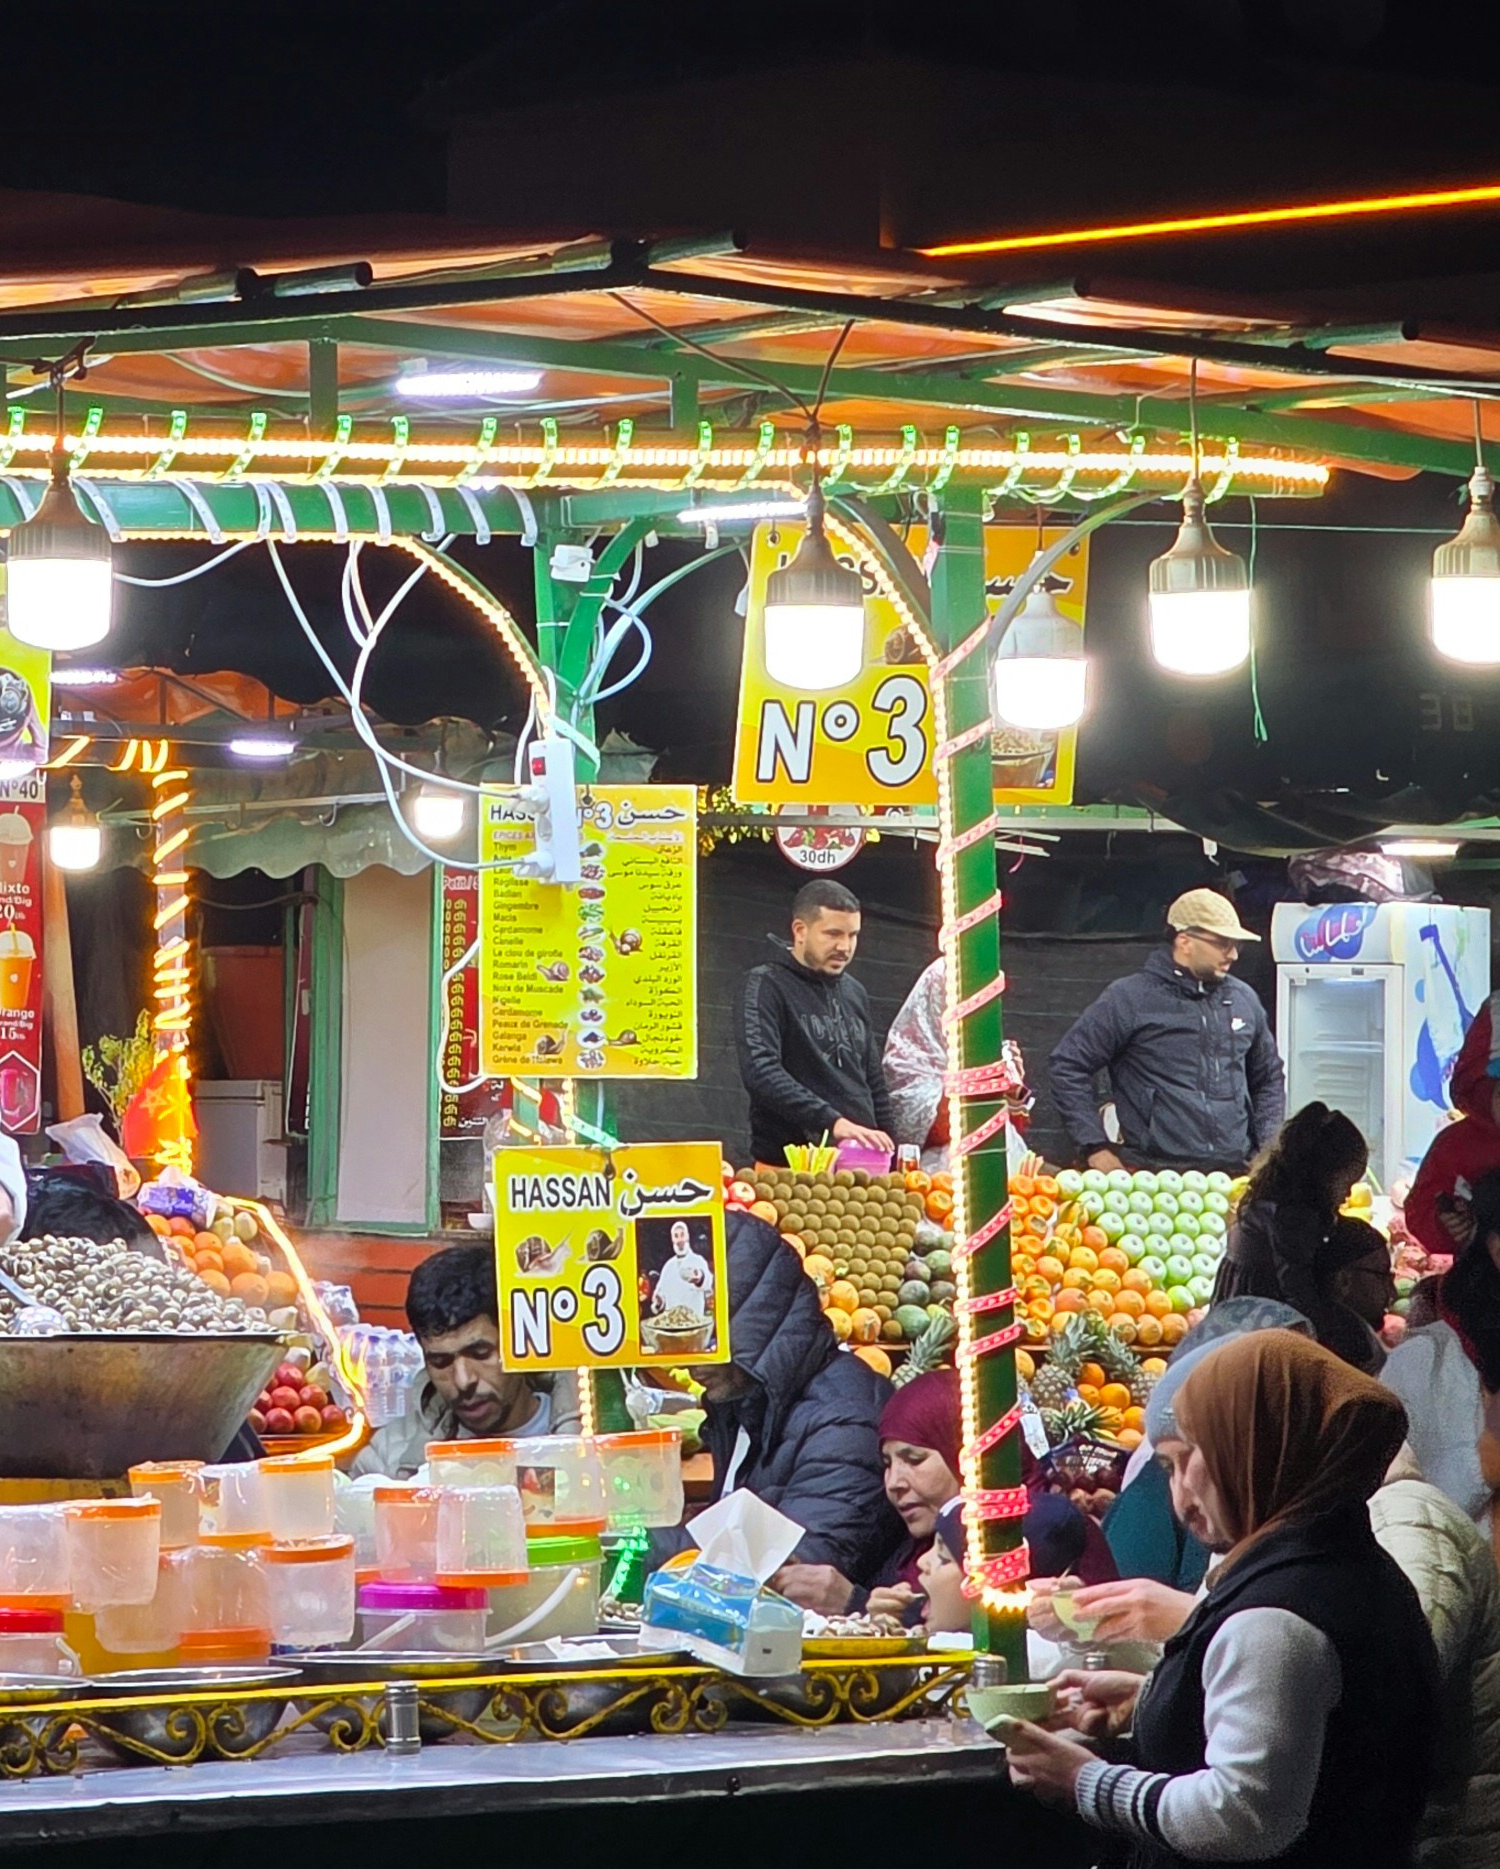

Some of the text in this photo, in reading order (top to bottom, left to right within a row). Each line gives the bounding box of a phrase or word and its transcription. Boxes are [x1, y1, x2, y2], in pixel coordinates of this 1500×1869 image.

[756, 674, 927, 787] N°3
[0, 780, 39, 799] N°40
[618, 802, 685, 825] حسن
[800, 850, 836, 863] 30dh
[511, 1176, 611, 1208] HASSAN
[620, 1171, 712, 1215] حسن
[511, 1263, 625, 1356] N°3
